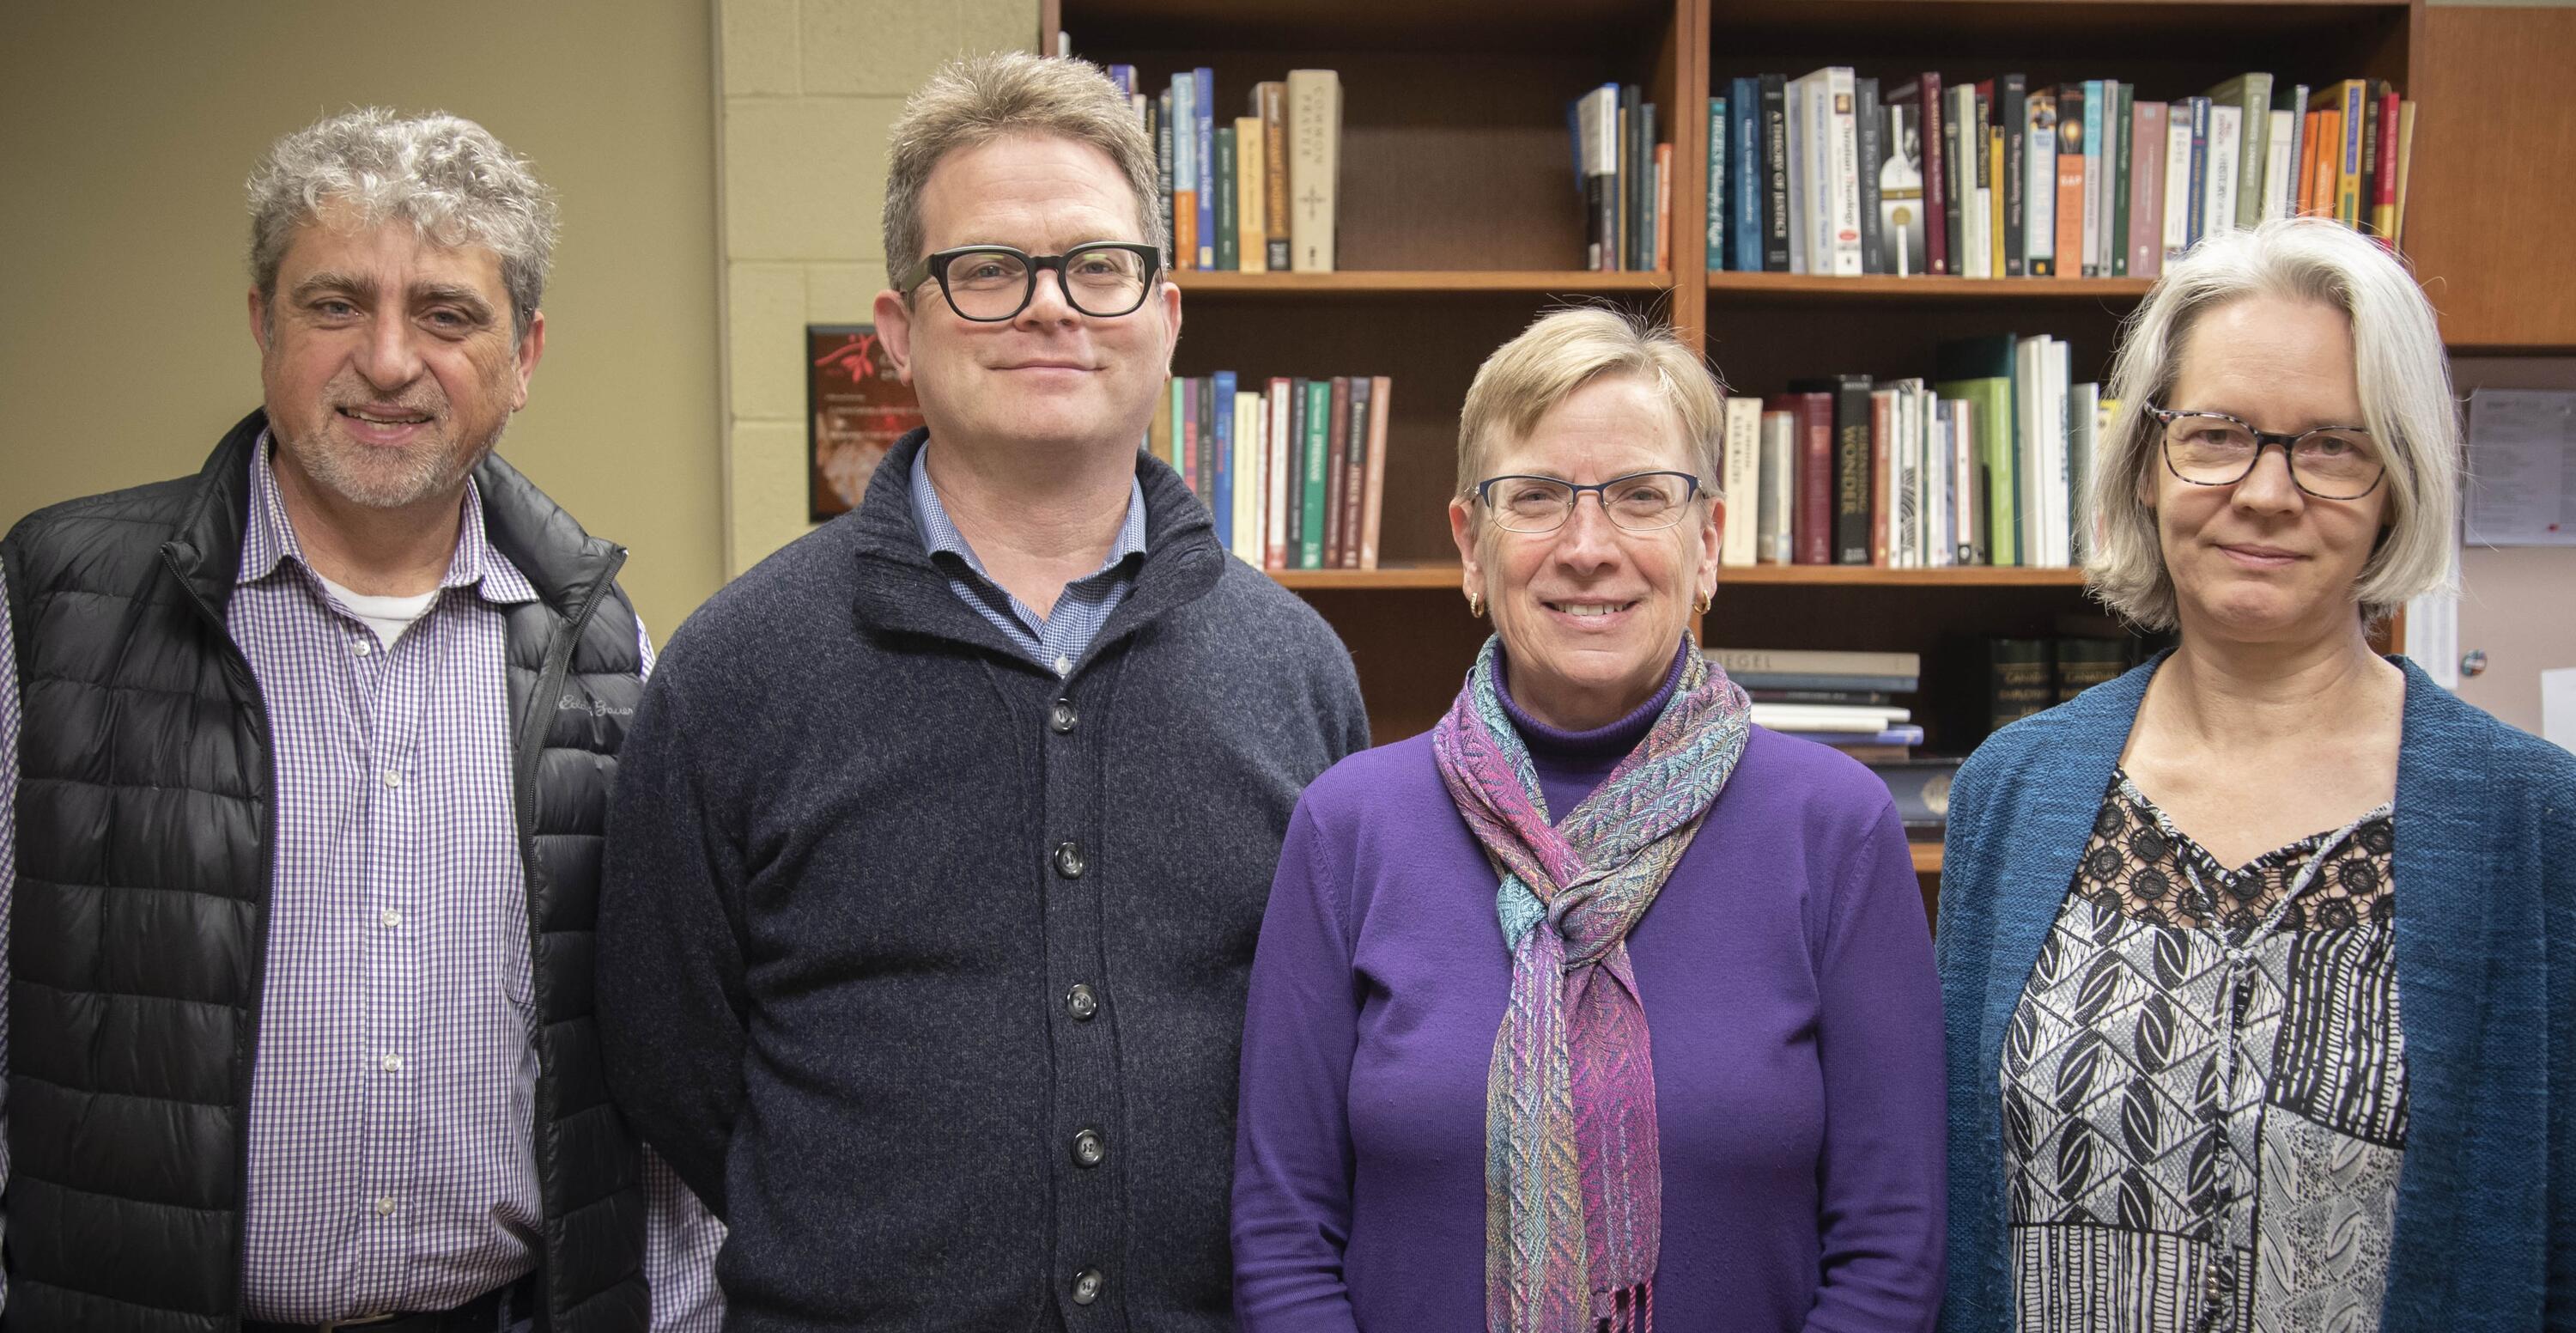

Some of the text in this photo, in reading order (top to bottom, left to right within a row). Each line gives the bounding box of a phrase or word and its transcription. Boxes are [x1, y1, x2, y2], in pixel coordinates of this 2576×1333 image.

[1301, 94, 1313, 157] PRAYER
[1314, 86, 1325, 164] COMMON
[1772, 111, 1783, 122] A
[1772, 124, 1784, 171] THEORY
[1774, 172, 1785, 190] OF
[1844, 176, 1857, 226] Theology
[1773, 191, 1786, 239] JUSTICE
[1348, 464, 1360, 503] JESUS
[1842, 425, 1857, 514] WONDER
[594, 699, 634, 716] Bauer
